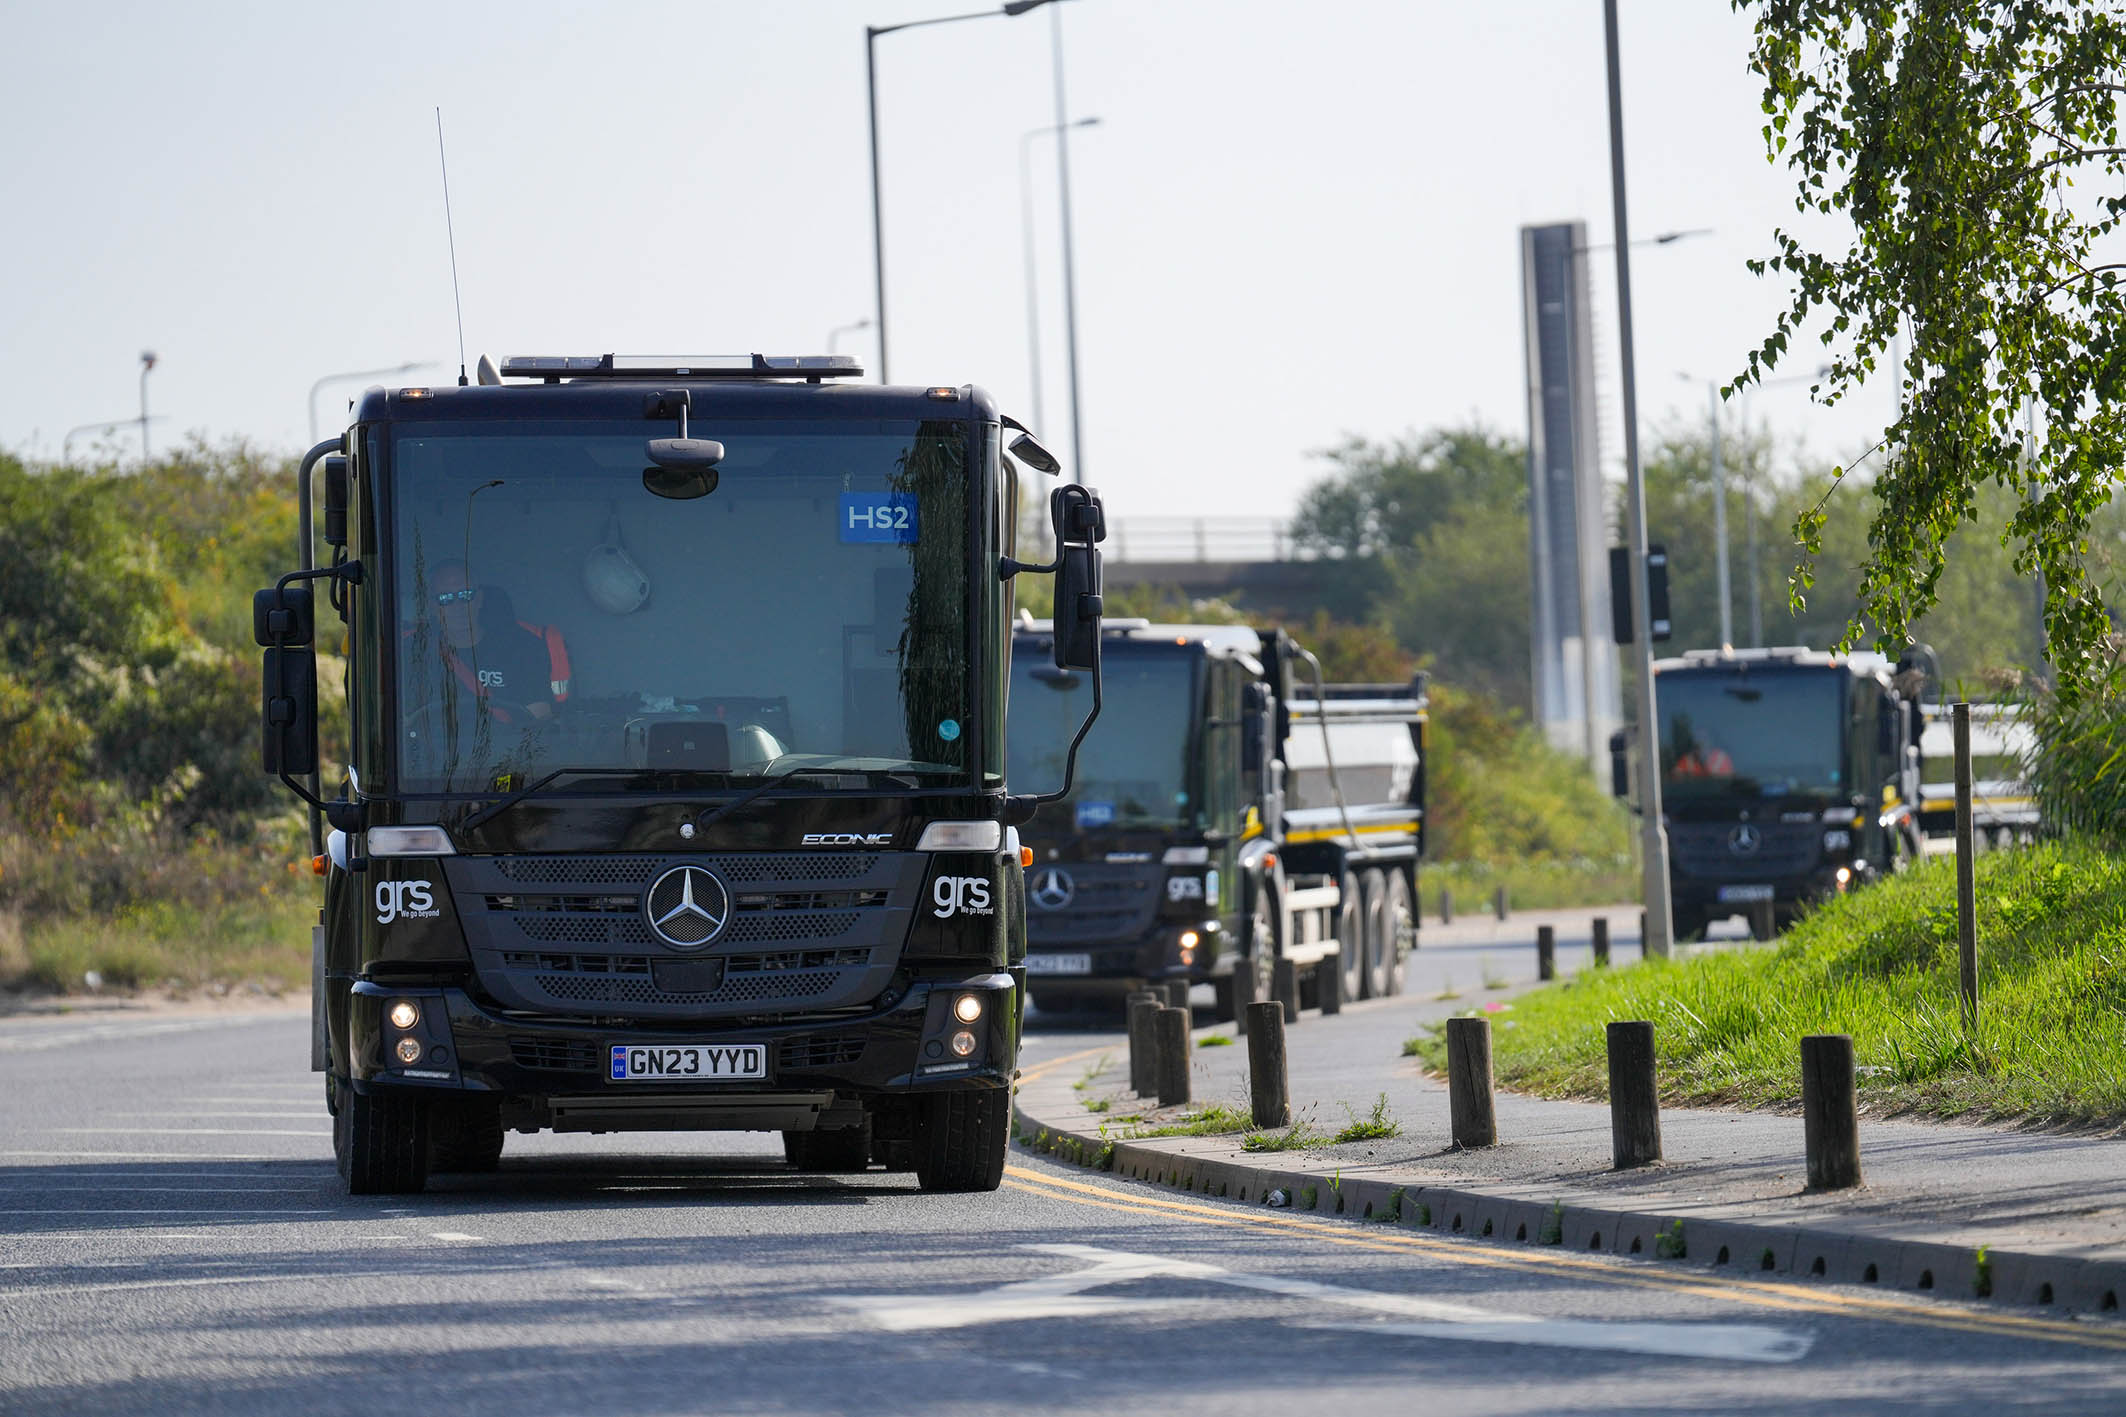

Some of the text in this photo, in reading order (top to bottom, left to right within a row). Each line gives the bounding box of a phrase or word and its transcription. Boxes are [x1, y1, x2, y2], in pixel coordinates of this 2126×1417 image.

[849, 506, 909, 529] HS2
[479, 670, 503, 687] grs
[801, 833, 893, 845] ECONIC
[376, 880, 433, 924] grs
[933, 875, 990, 918] grs
[410, 911, 417, 919] go
[418, 909, 440, 919] beyond
[615, 1065, 625, 1073] UK
[630, 1049, 759, 1074] GN23 YYD
